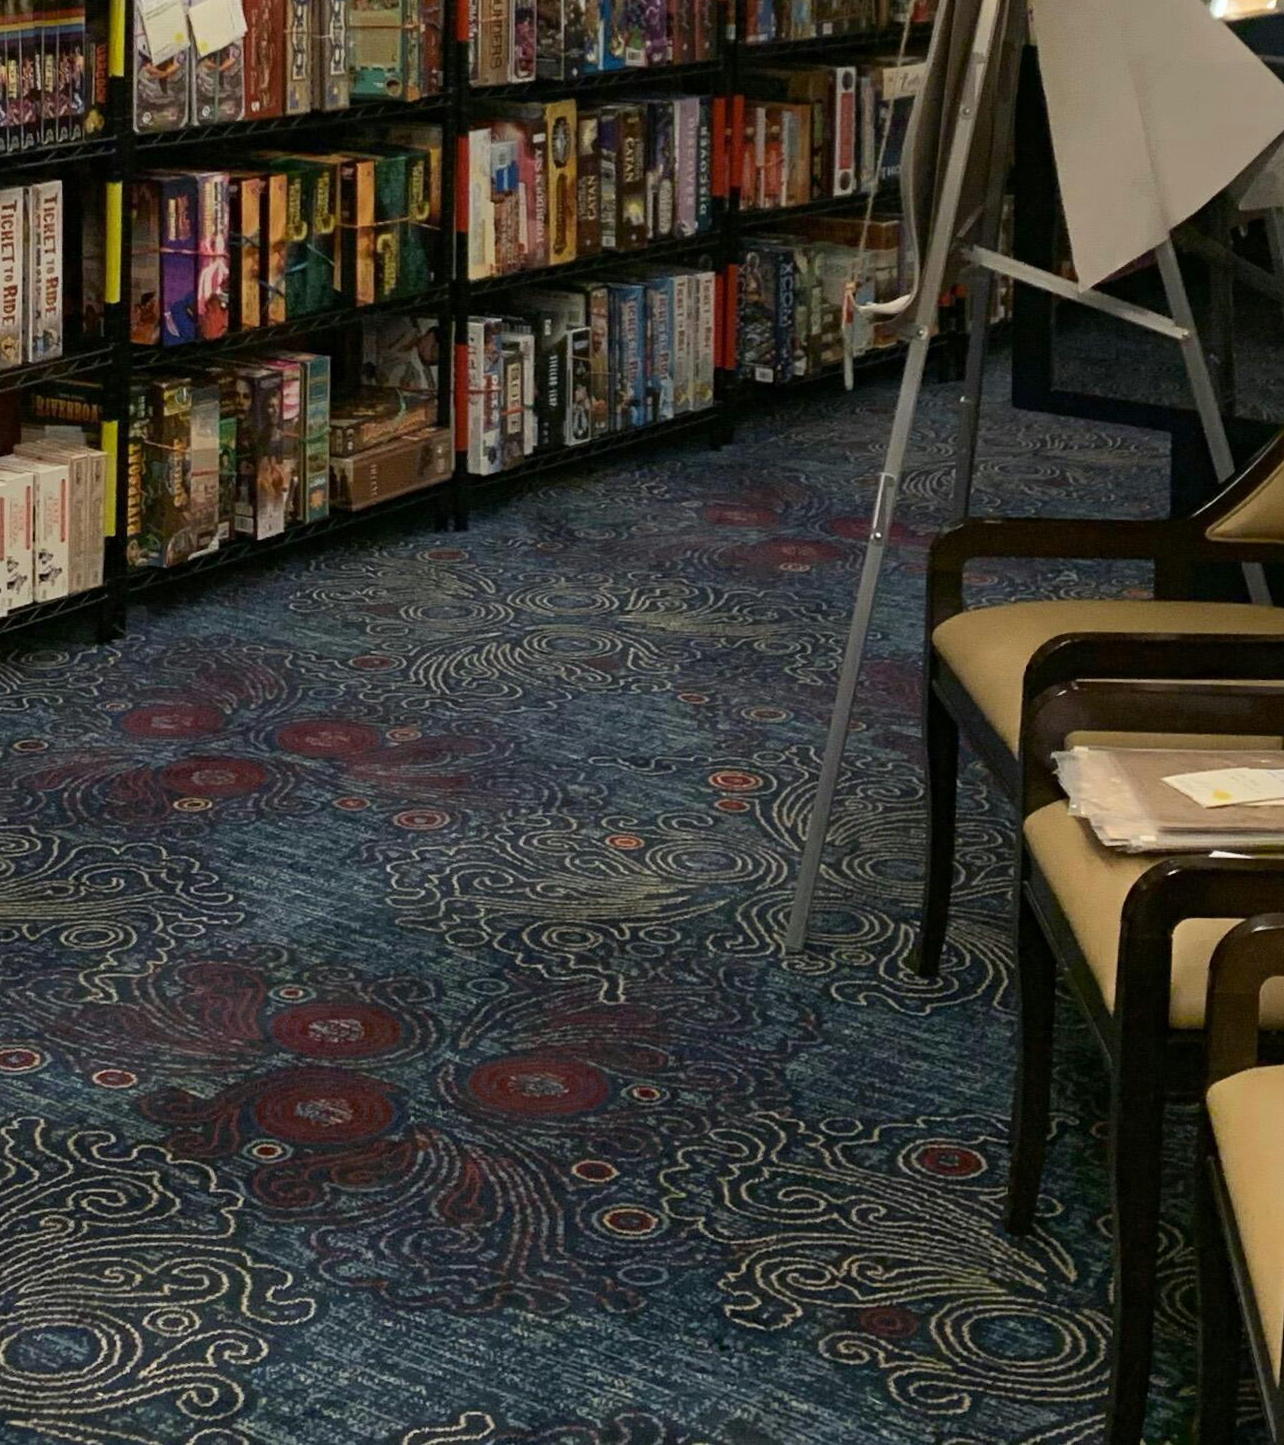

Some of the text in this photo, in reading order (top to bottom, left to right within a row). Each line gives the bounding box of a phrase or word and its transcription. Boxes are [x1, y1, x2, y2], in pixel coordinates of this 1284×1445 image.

[587, 175, 597, 221] CATAN
[625, 137, 635, 183] CATAN
[0, 200, 18, 326] TICKET TO RIDE
[41, 192, 59, 317] TICKET TO RIDE
